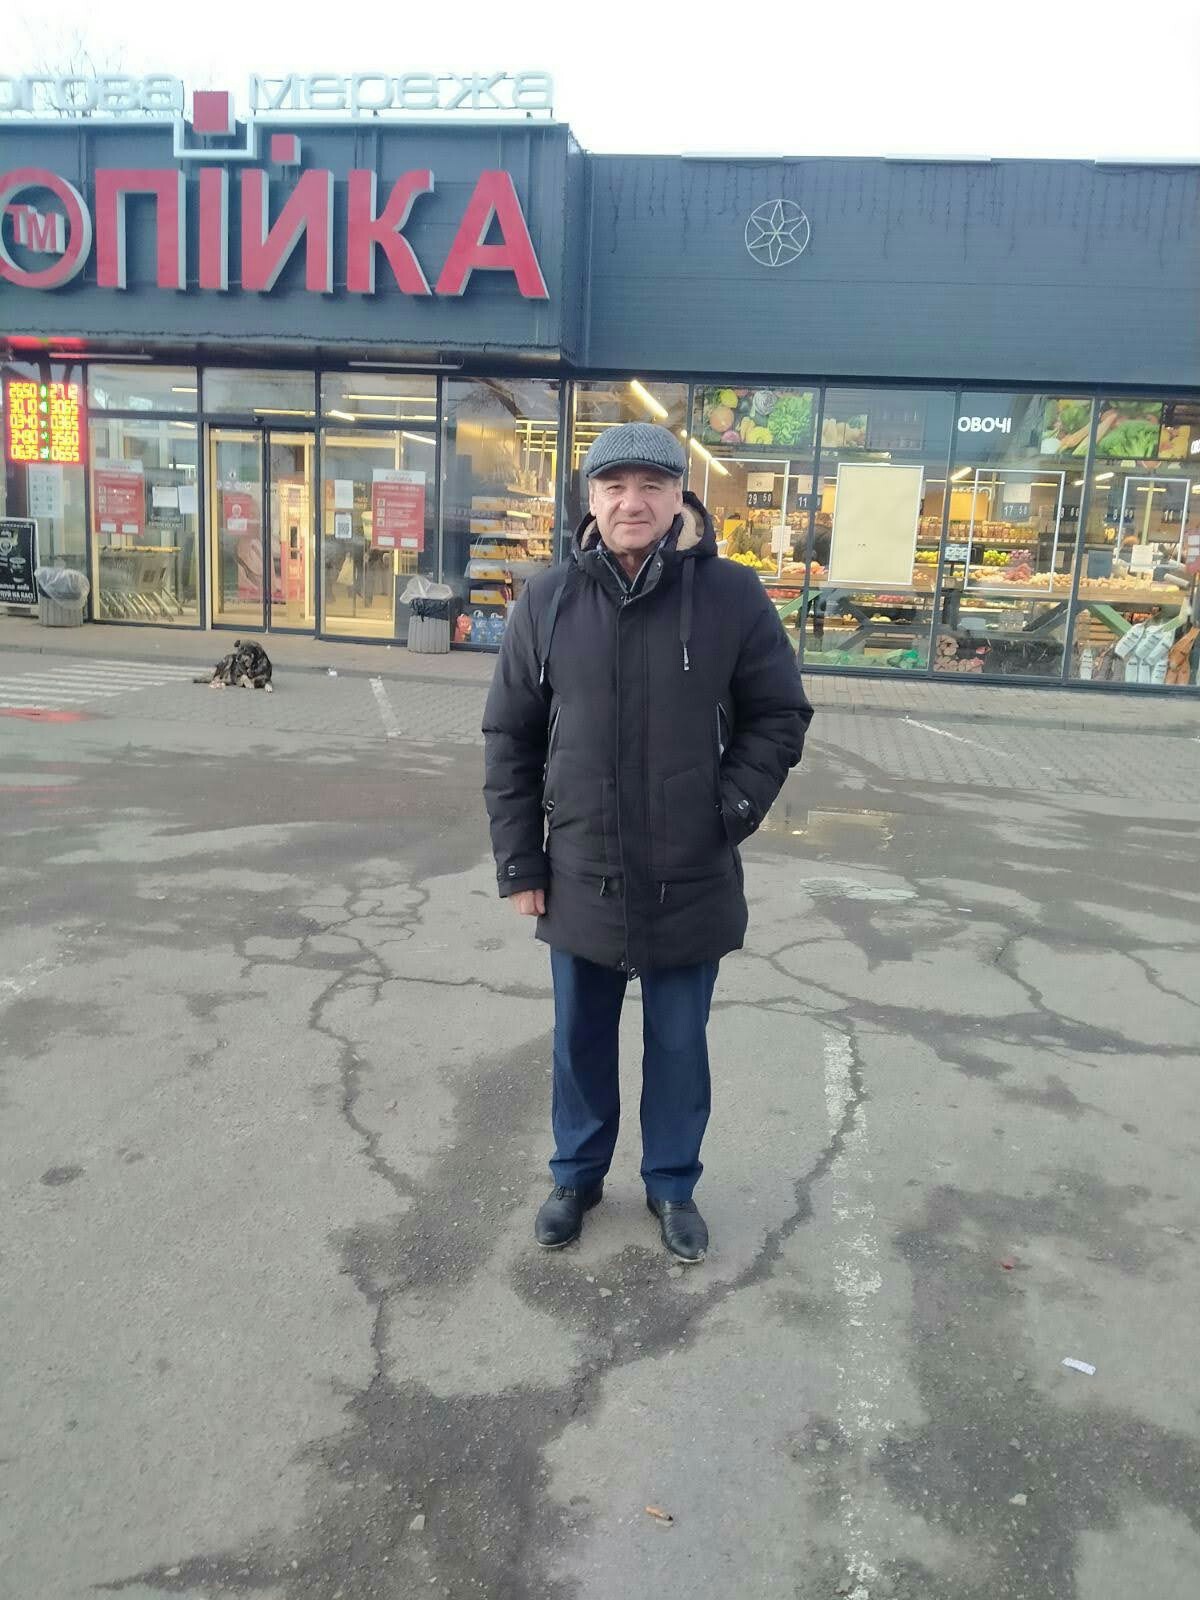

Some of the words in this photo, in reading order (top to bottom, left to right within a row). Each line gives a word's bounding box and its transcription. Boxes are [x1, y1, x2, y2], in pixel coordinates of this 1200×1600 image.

[249, 72, 553, 117] мережа
[4, 204, 65, 254] ТМ
[957, 416, 1012, 434] ОВОЧІ
[748, 493, 758, 505] 29
[763, 493, 772, 503] 50
